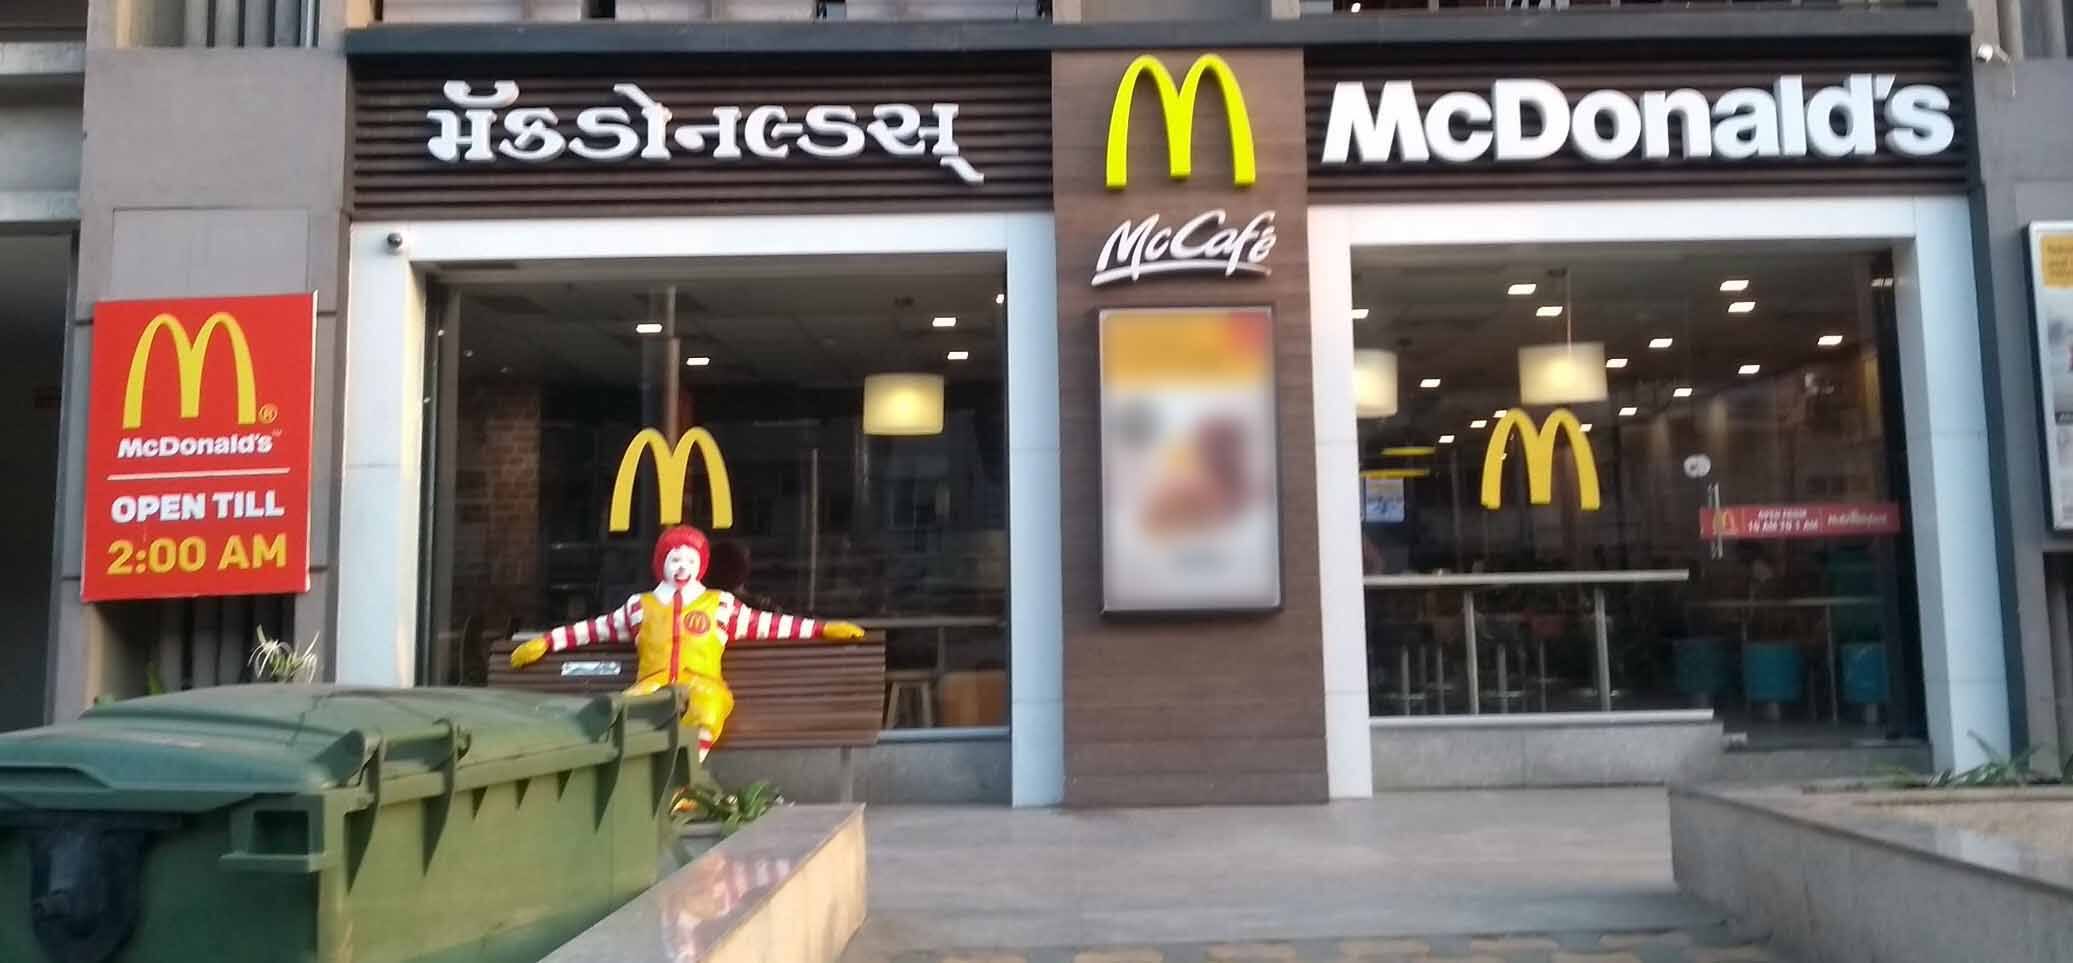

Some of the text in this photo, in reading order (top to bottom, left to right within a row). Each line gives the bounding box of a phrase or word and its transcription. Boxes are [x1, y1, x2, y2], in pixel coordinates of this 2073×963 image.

[1321, 73, 1955, 163] McDonald's
[1091, 208, 1278, 286] McCafé
[117, 433, 273, 459] McDonald's
[111, 490, 285, 524] OPEN TILL
[106, 532, 287, 576] 2:00 AM
